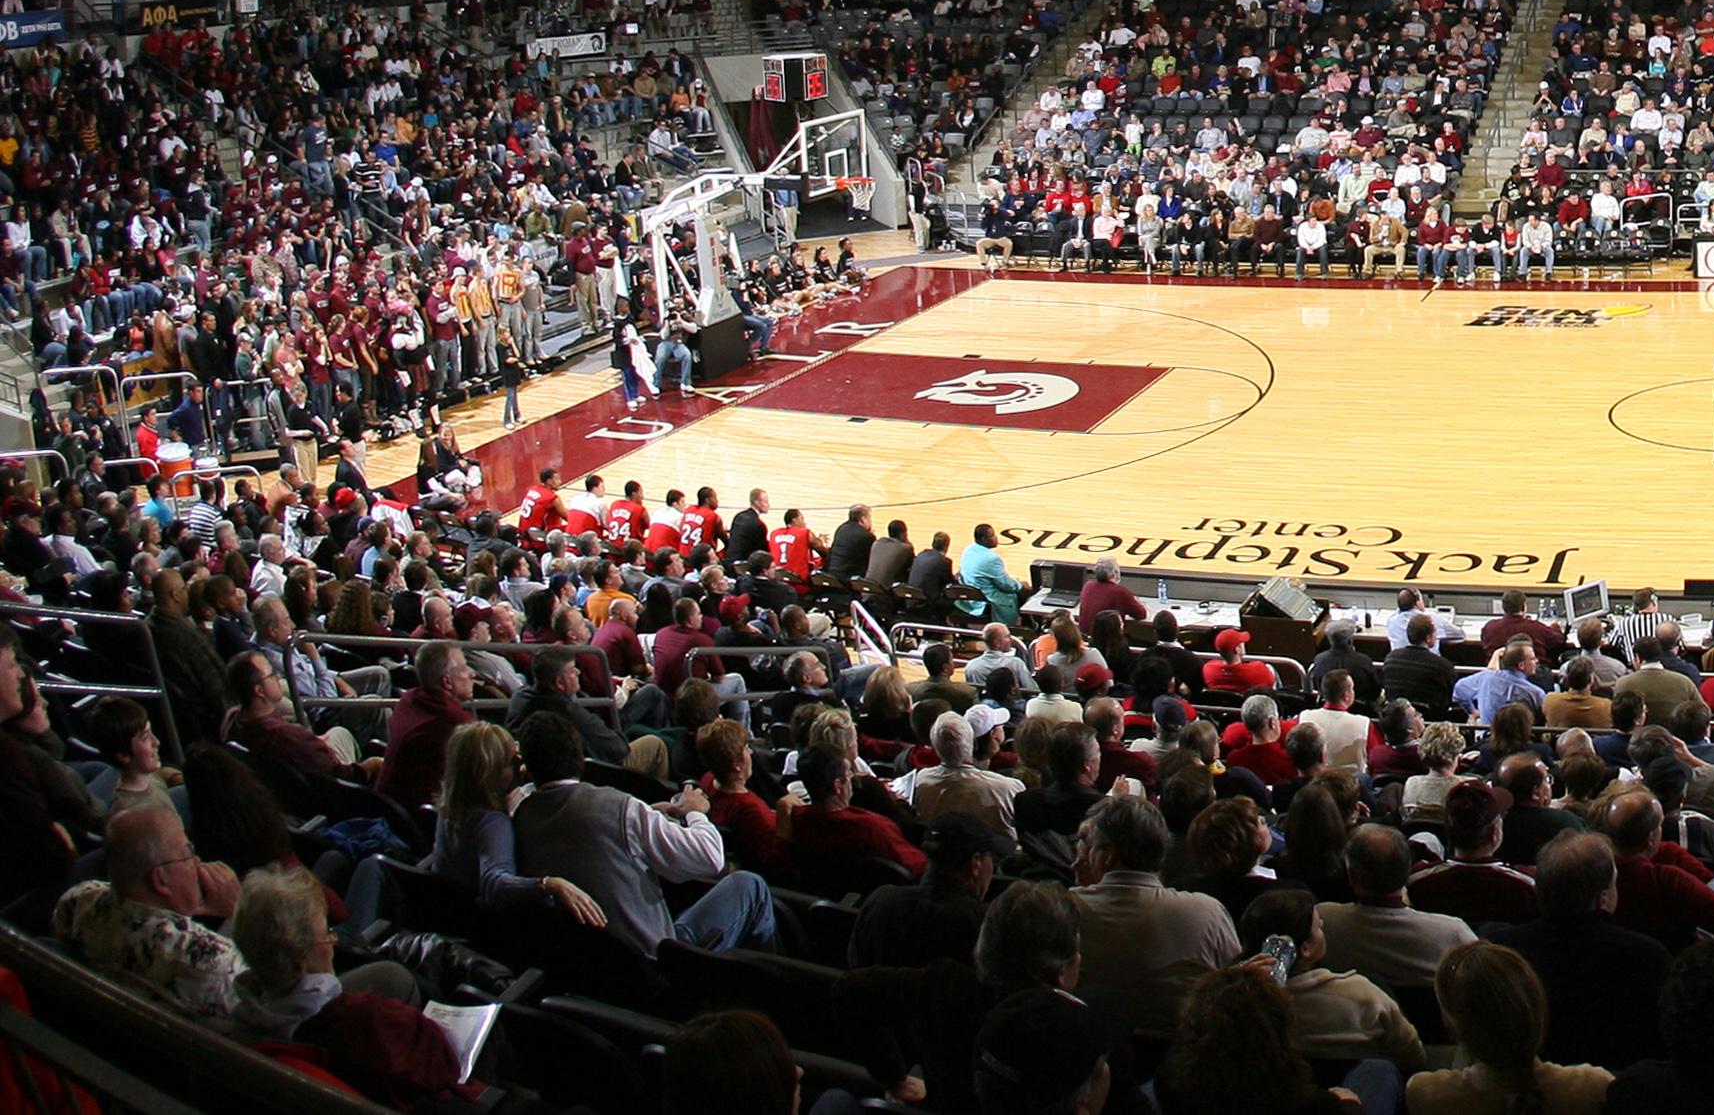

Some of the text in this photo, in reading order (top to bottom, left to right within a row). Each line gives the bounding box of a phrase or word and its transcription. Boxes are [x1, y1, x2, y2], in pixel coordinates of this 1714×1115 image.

[609, 521, 631, 541] 34
[681, 524, 703, 546] 24
[1180, 516, 1404, 548] Center
[780, 544, 788, 564] 1
[999, 527, 1580, 585] Jack Stephens
